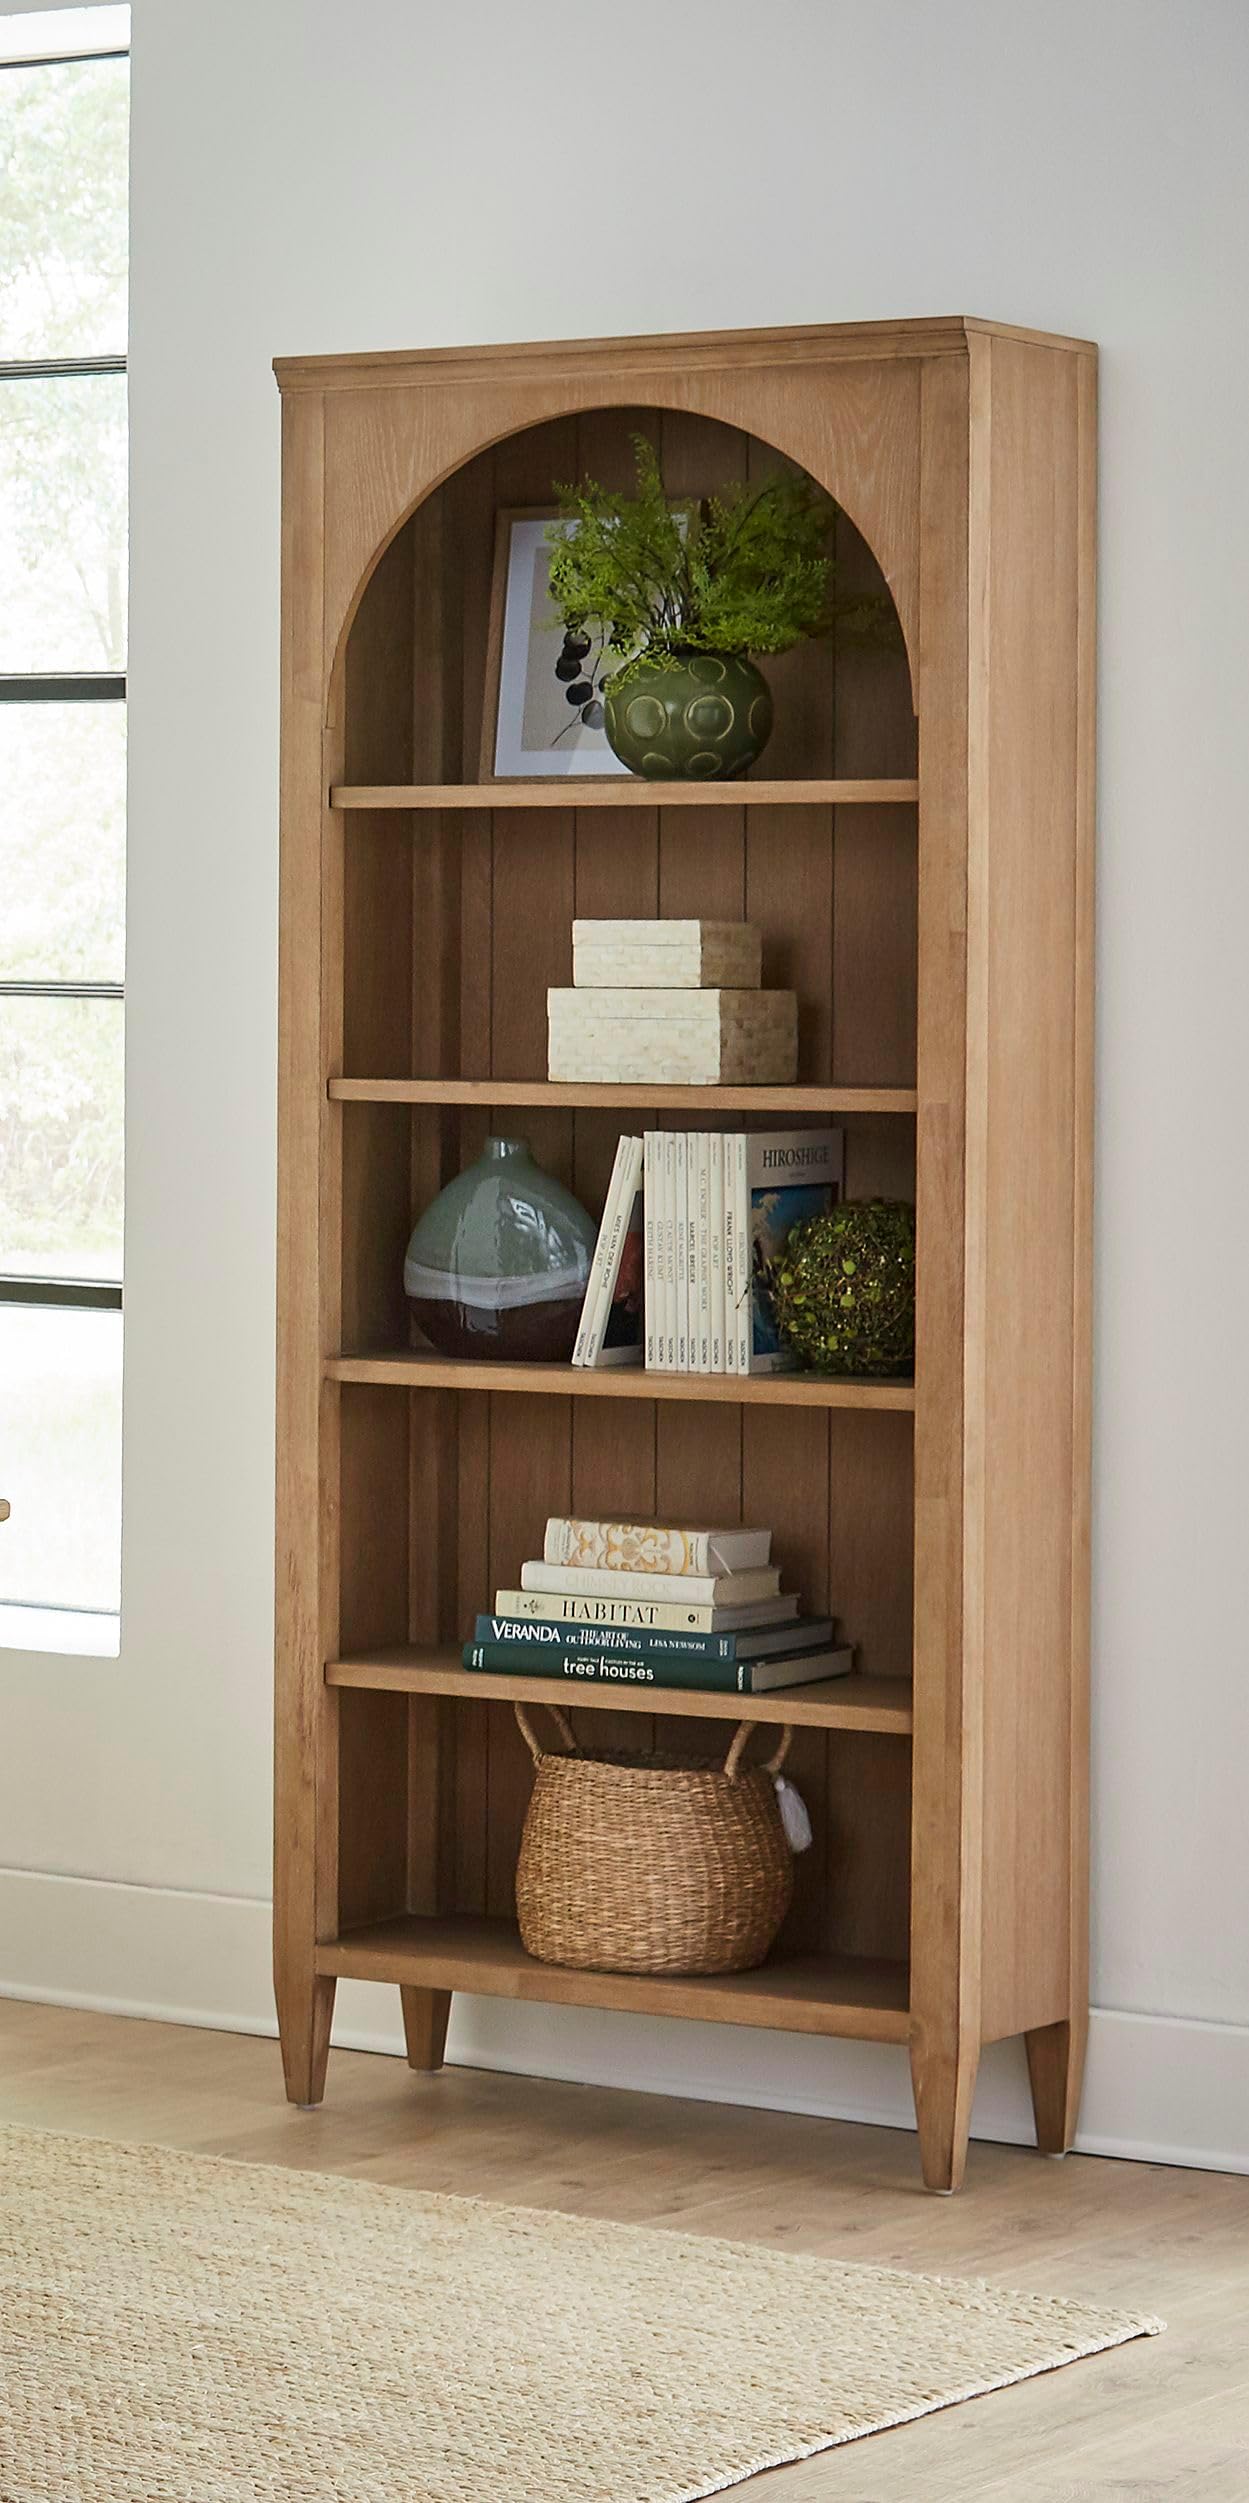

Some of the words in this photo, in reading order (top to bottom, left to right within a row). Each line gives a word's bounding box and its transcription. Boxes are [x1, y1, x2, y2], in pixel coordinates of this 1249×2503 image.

[763, 1145, 830, 1168] HIROSHIGE
[562, 1600, 659, 1624] HABITAT
[491, 1620, 560, 1643] VERANDA
[649, 1638, 668, 1648] LISA
[563, 1657, 596, 1676] tree
[600, 1656, 655, 1680] houses
